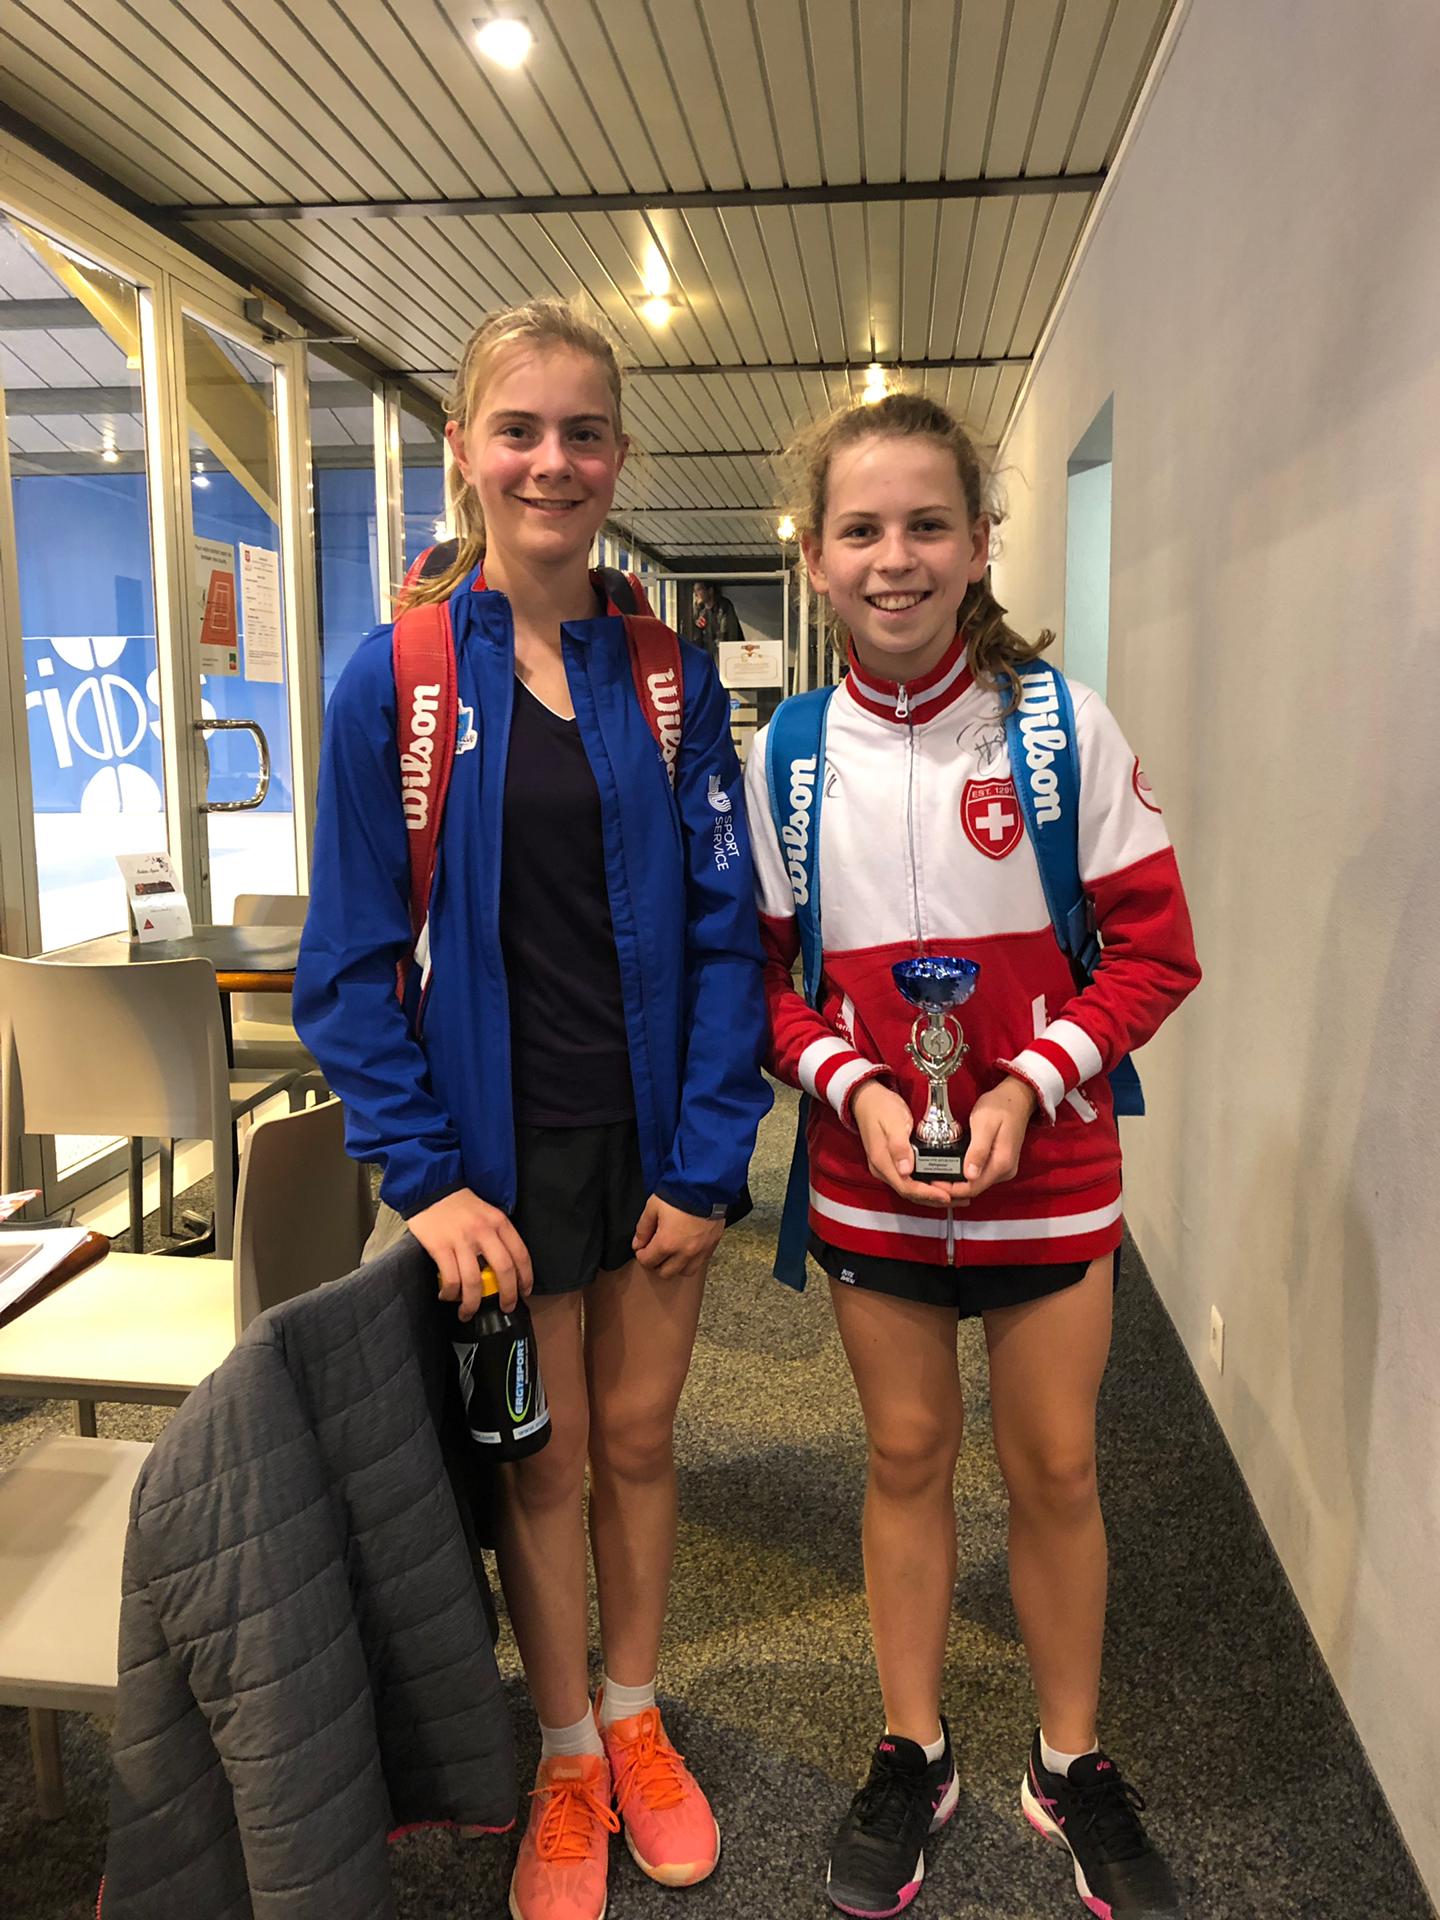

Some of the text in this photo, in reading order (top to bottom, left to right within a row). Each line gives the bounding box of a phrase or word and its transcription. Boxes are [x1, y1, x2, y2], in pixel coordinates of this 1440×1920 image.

[400, 683, 440, 829] Wilson
[647, 668, 682, 793] Wilso
[1018, 671, 1067, 826] Wilson
[713, 816, 729, 871] SERVICE
[724, 816, 739, 856] SPORT
[782, 757, 816, 905] Wilson
